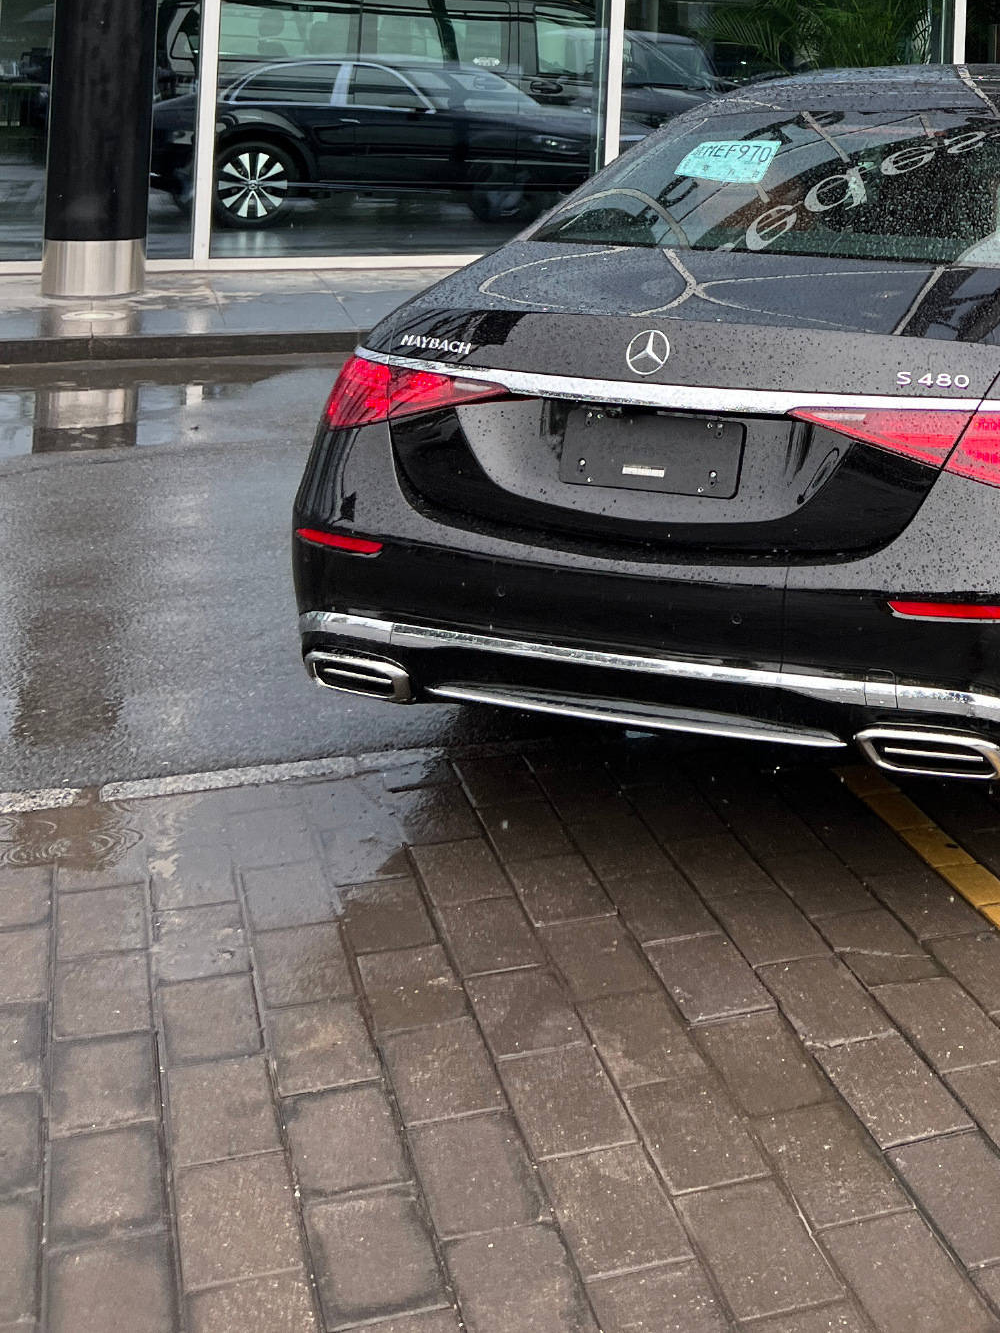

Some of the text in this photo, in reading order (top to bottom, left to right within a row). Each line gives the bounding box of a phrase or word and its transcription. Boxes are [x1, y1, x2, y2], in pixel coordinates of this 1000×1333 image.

[400, 334, 473, 355] MAYBACH
[896, 371, 970, 389] S 480
